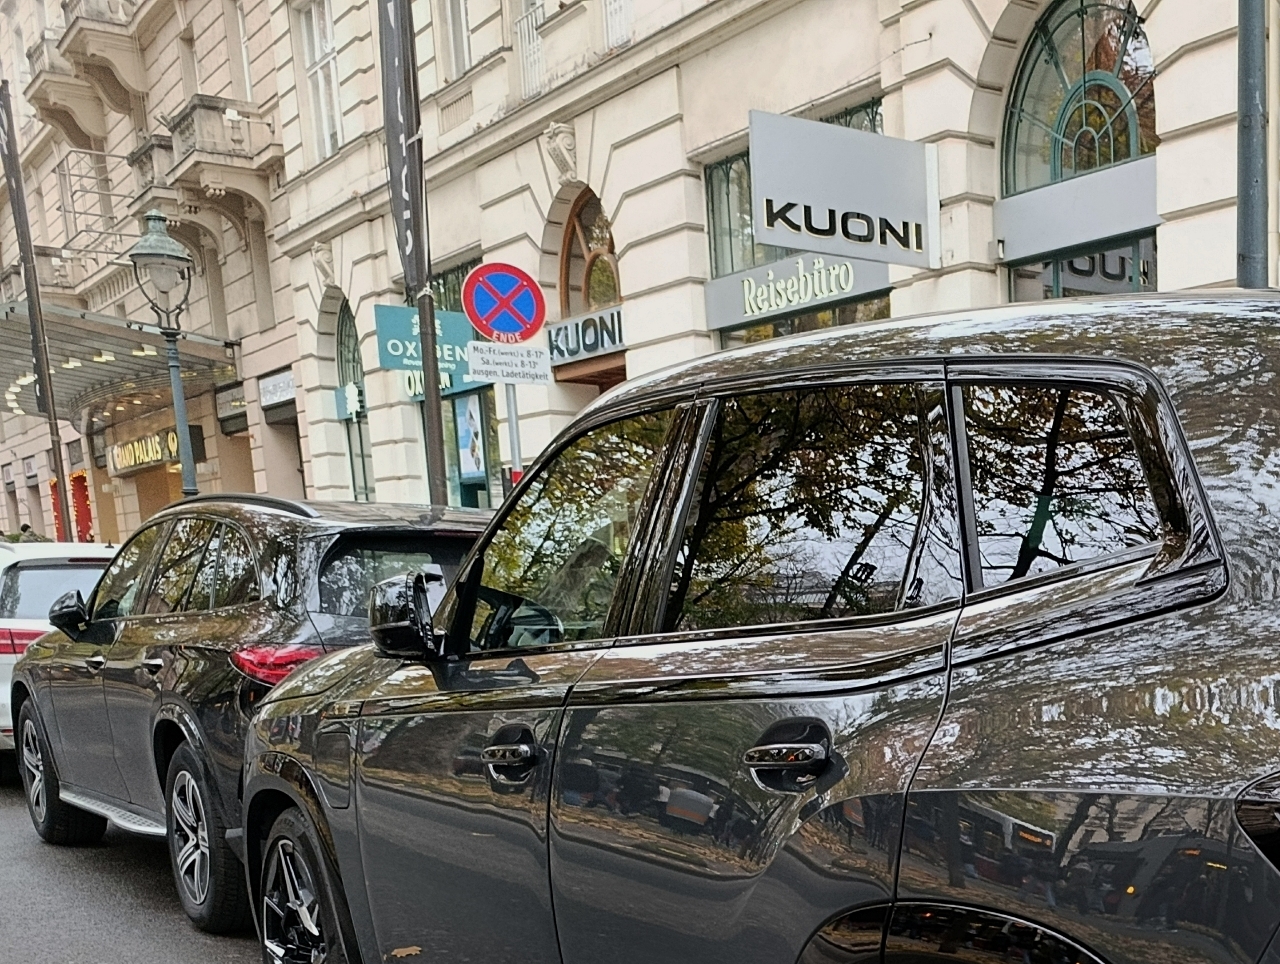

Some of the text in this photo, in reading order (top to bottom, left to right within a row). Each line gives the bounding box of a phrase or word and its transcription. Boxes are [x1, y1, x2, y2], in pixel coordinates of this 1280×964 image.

[764, 197, 924, 253] KUONI
[742, 257, 854, 317] Reisebüro
[492, 330, 524, 343] ENDE
[548, 310, 623, 360] KUONI
[387, 339, 470, 362] OXEN
[481, 357, 492, 366] Sa.
[472, 368, 549, 381] ausgen. Ladetätigkeit
[133, 435, 162, 464] PALAIS
